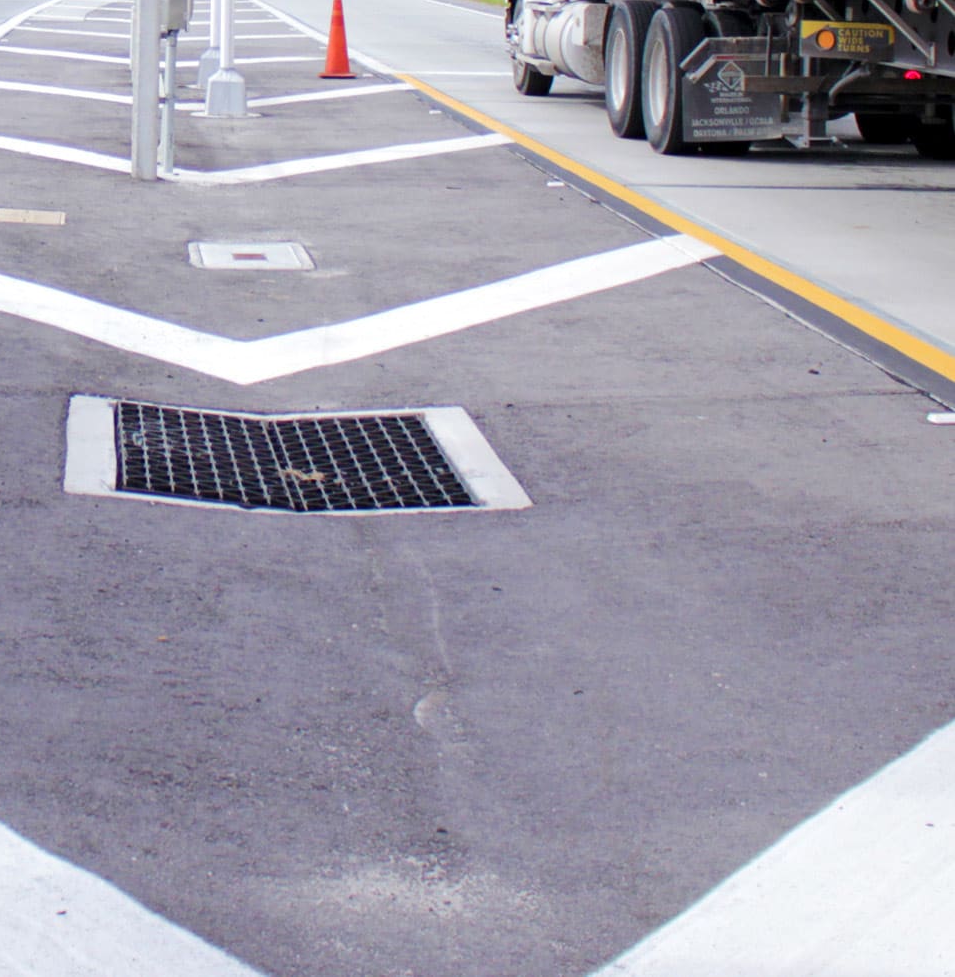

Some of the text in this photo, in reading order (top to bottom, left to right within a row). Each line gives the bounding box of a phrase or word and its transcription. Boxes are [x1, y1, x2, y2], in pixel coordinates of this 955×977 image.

[838, 29, 884, 38] CAUTION
[837, 44, 871, 53] TURNS
[714, 106, 750, 115] ORLANDO
[691, 118, 743, 127] JACKSONVILLE
[693, 129, 727, 138] DAYTONA
